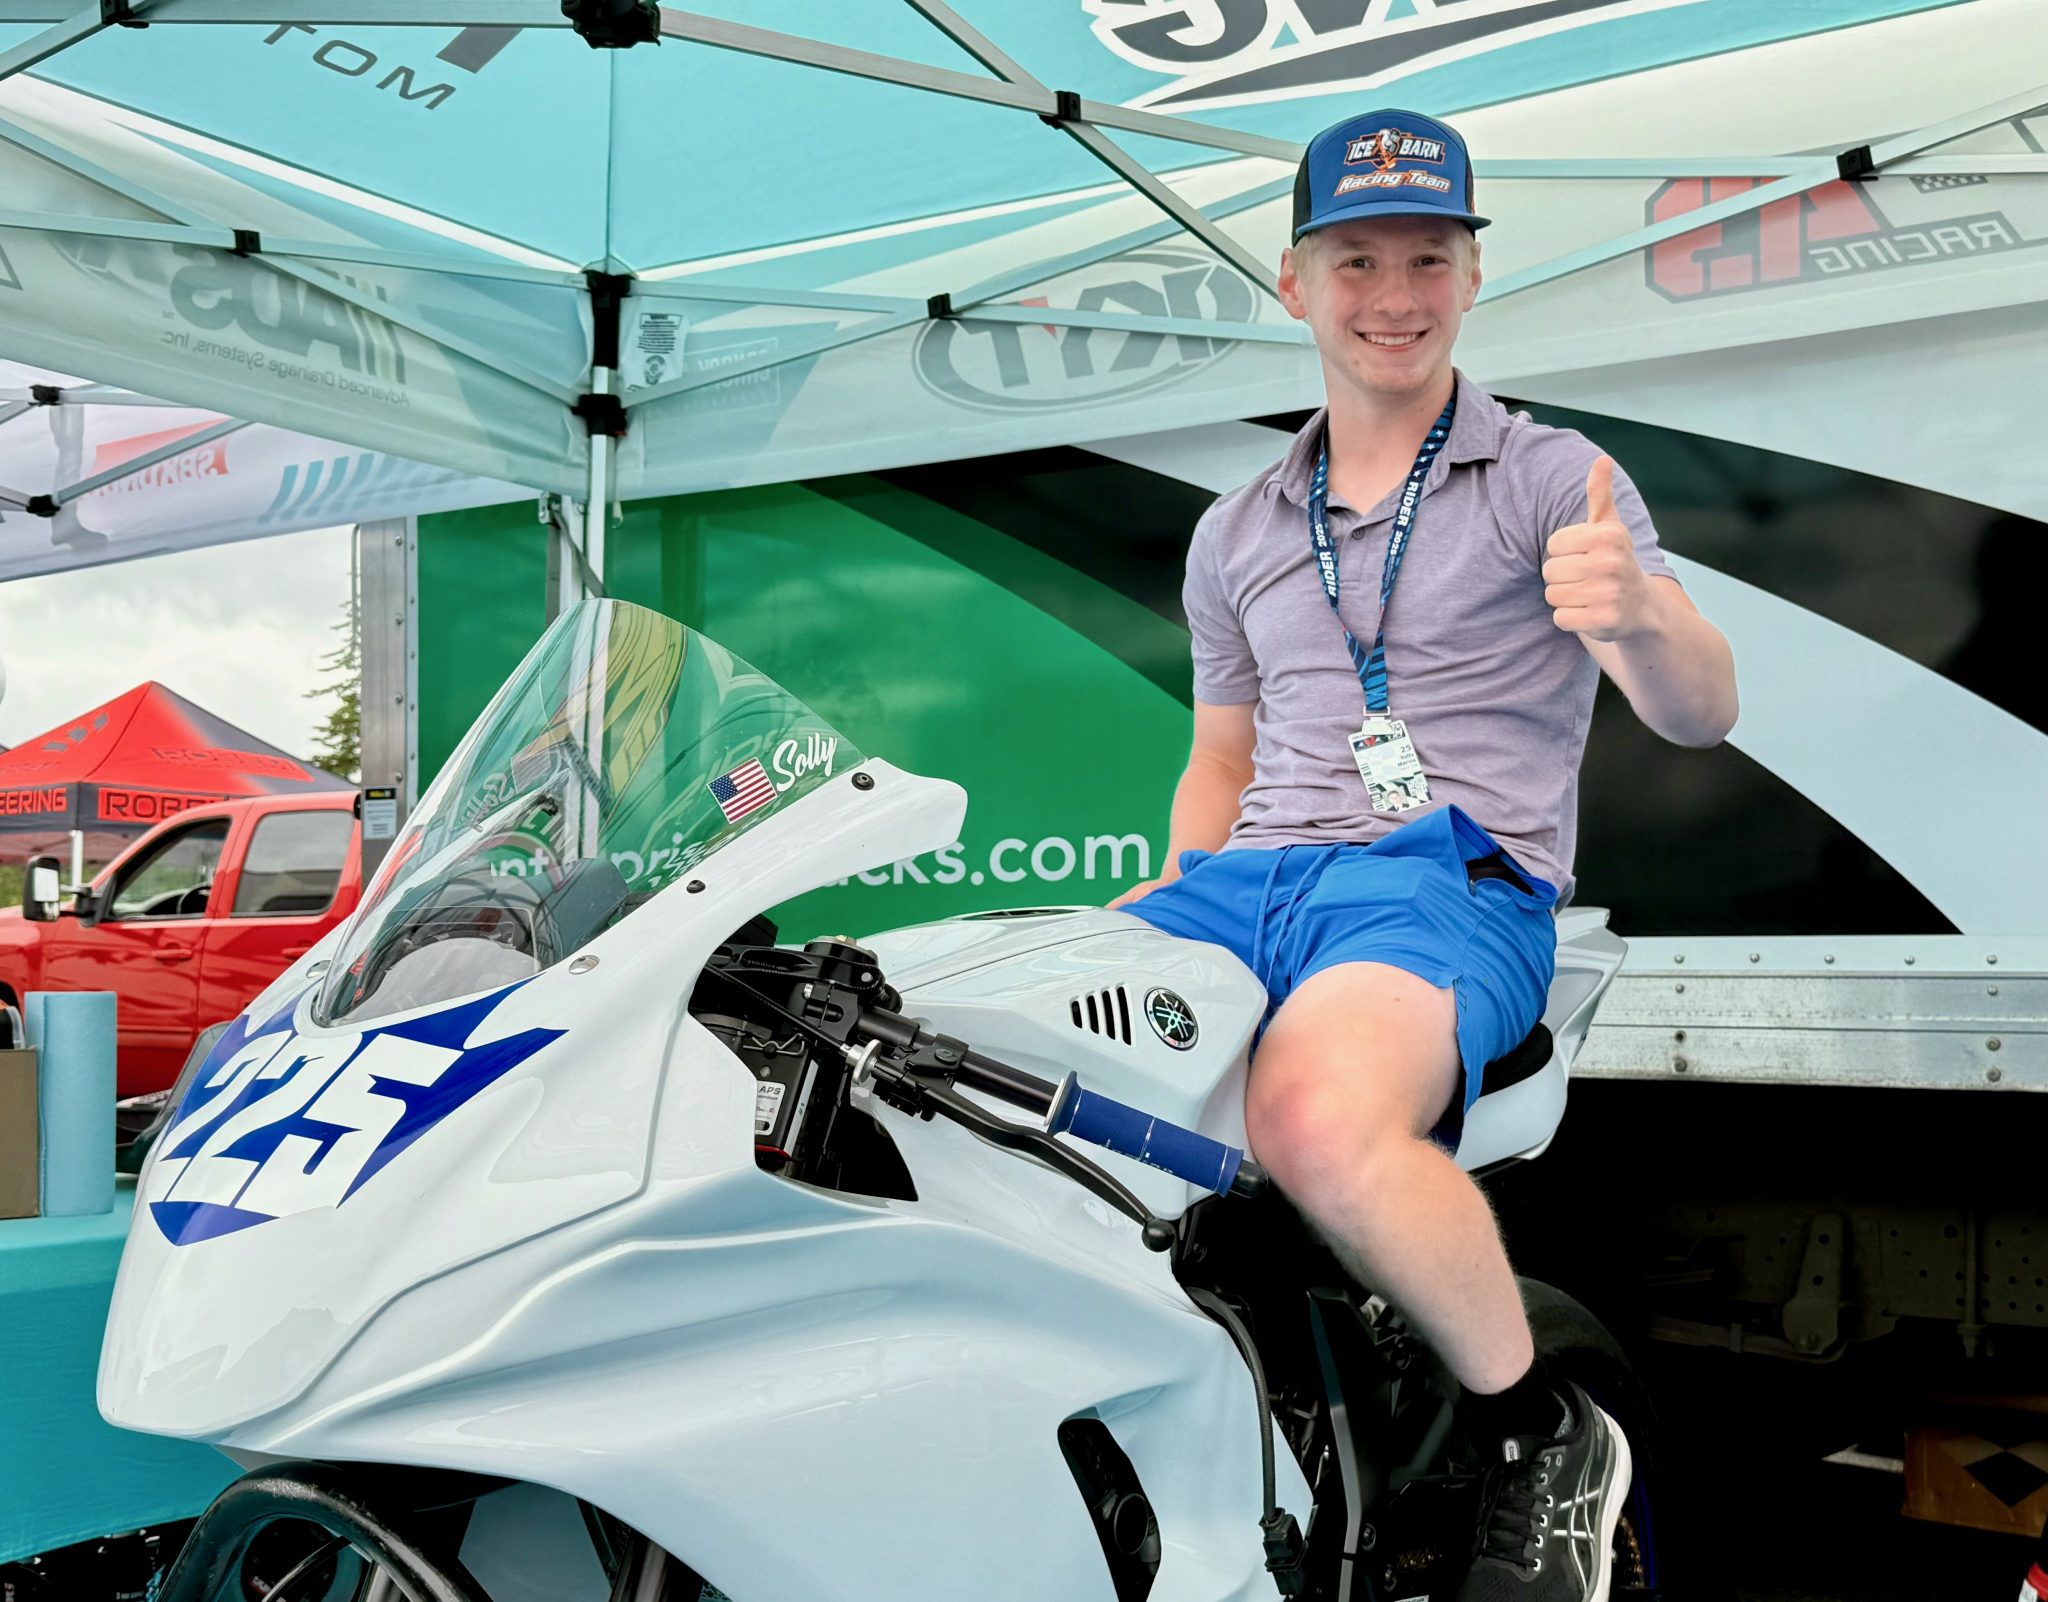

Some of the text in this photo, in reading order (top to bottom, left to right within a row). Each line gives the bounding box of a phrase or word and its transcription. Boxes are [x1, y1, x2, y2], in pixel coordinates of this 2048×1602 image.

[1348, 139, 1441, 160] ICE BARN
[1339, 171, 1450, 193] Racing Team
[1315, 523, 1328, 548] 2025
[1390, 481, 1419, 556] RIDER 2025
[1319, 550, 1337, 598] RIDER
[772, 732, 838, 792] Solly
[147, 1029, 464, 1219] 225
